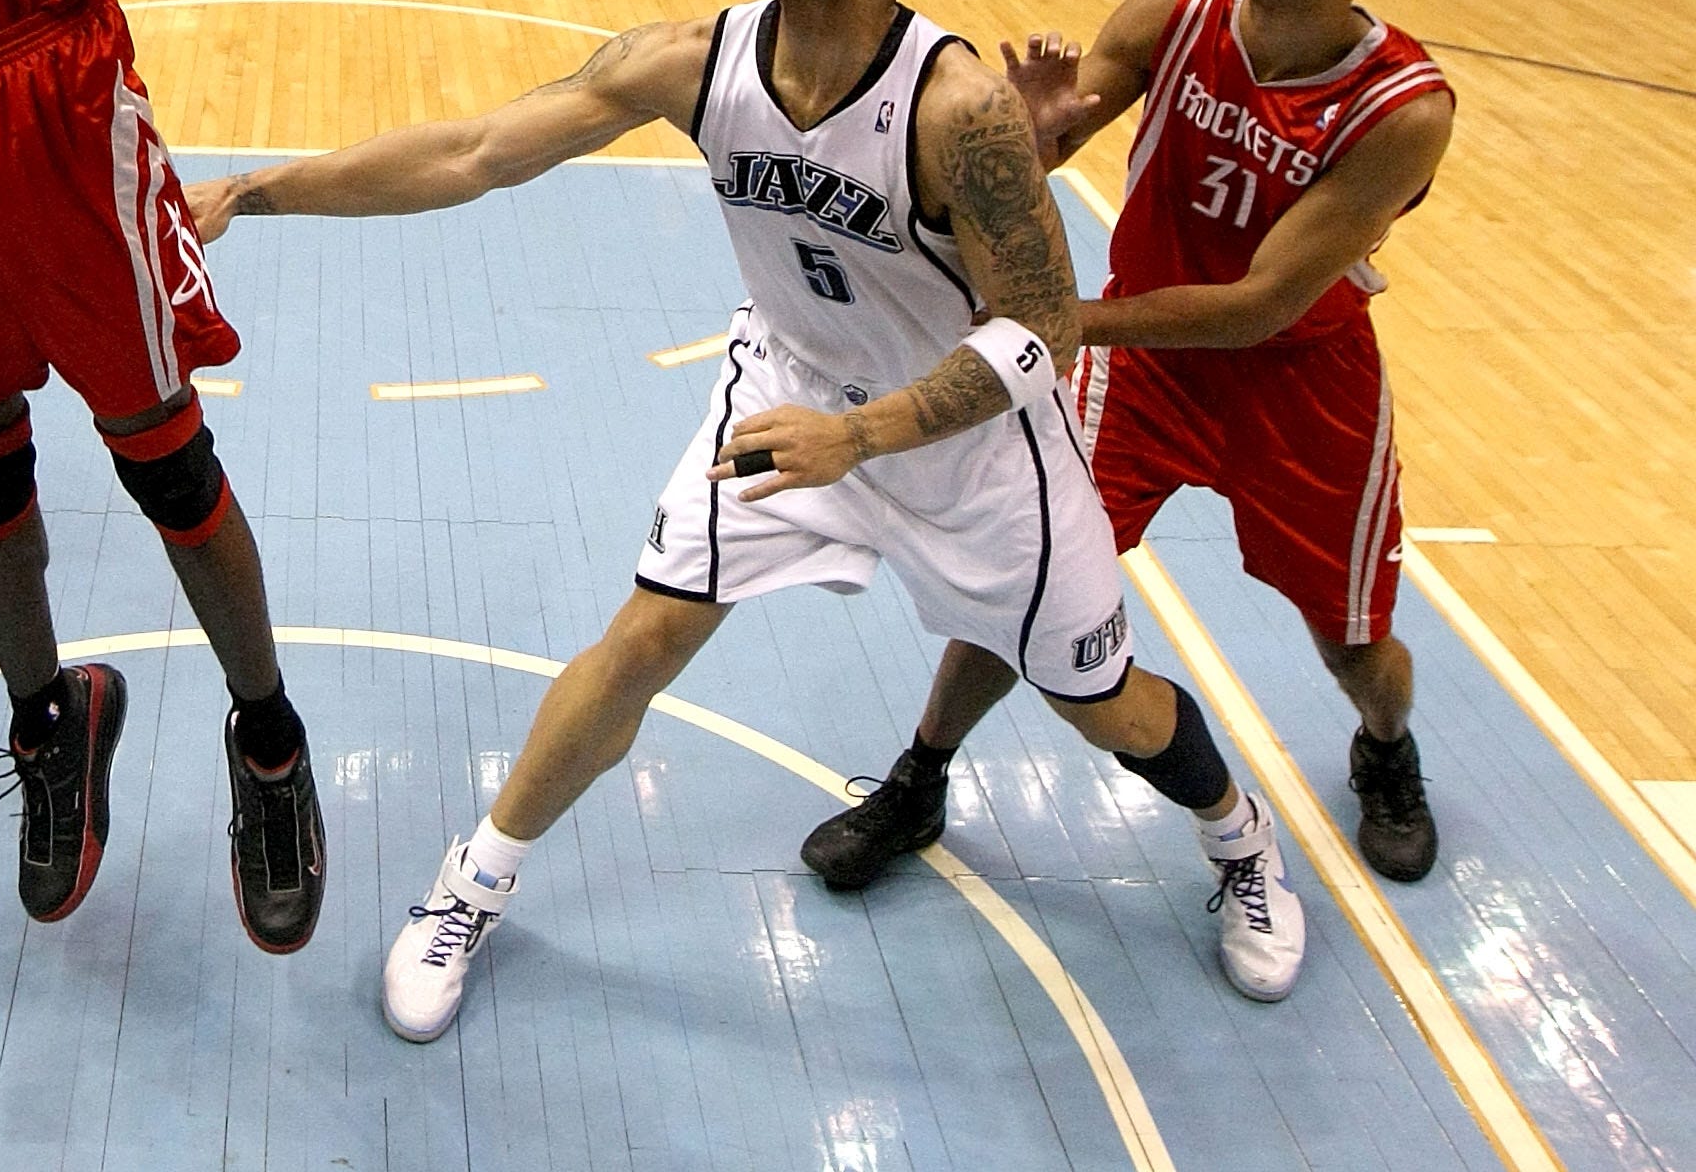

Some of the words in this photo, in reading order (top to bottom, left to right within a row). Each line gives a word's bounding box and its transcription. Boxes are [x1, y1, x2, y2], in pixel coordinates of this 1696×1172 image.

[1175, 72, 1319, 187] ROCKETS
[712, 151, 904, 254] JAZZ
[1190, 154, 1259, 229] 31
[790, 237, 856, 305] 5
[1015, 339, 1045, 374] 5
